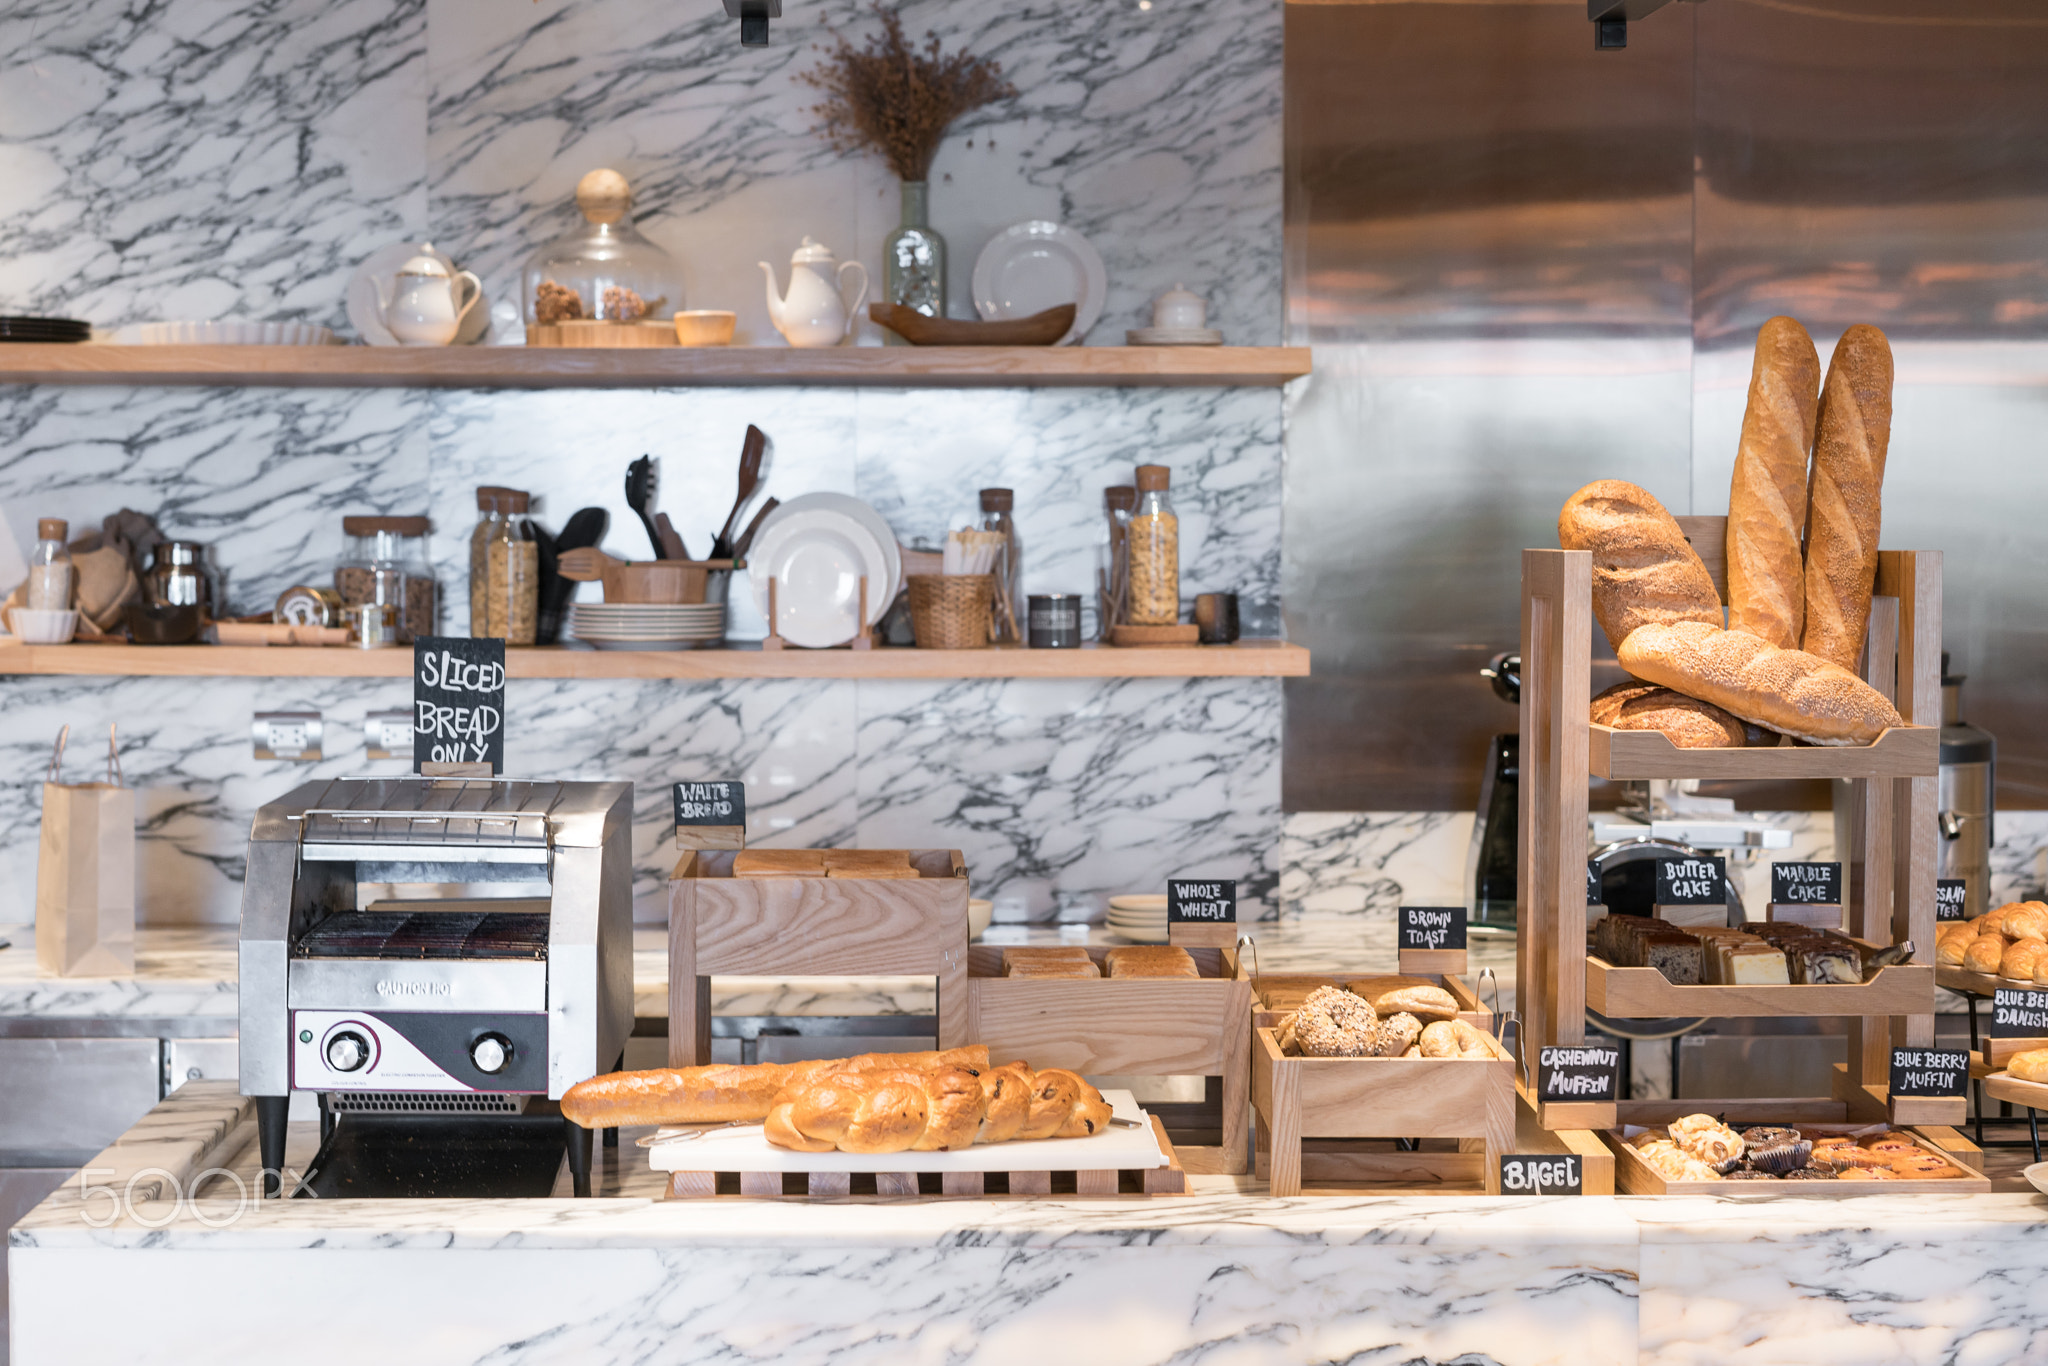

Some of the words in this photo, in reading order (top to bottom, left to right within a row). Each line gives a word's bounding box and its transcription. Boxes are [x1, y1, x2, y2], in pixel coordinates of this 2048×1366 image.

[421, 650, 505, 693] SLICED
[415, 700, 500, 747] BREAD
[679, 783, 730, 801] WHITE
[680, 801, 732, 819] BREAD
[1665, 860, 1718, 880] BUTTER
[1775, 865, 1831, 883] MARBLE
[1174, 883, 1222, 899] WHOLE
[1672, 880, 1711, 899] CAKE
[1787, 883, 1827, 902] CAKE
[1177, 900, 1231, 920] WHEAT
[1408, 910, 1452, 928] BROWN
[1406, 929, 1449, 950] TOAST
[374, 979, 428, 997] CAUTION
[1994, 989, 2025, 1007] BLUE
[1893, 1051, 1923, 1068] BLUE
[1923, 1052, 1968, 1070] BERRY
[1547, 1070, 1610, 1095] MUFFIN
[1900, 1071, 1957, 1091] MUFFIN
[1503, 1157, 1580, 1196] BAGEL
